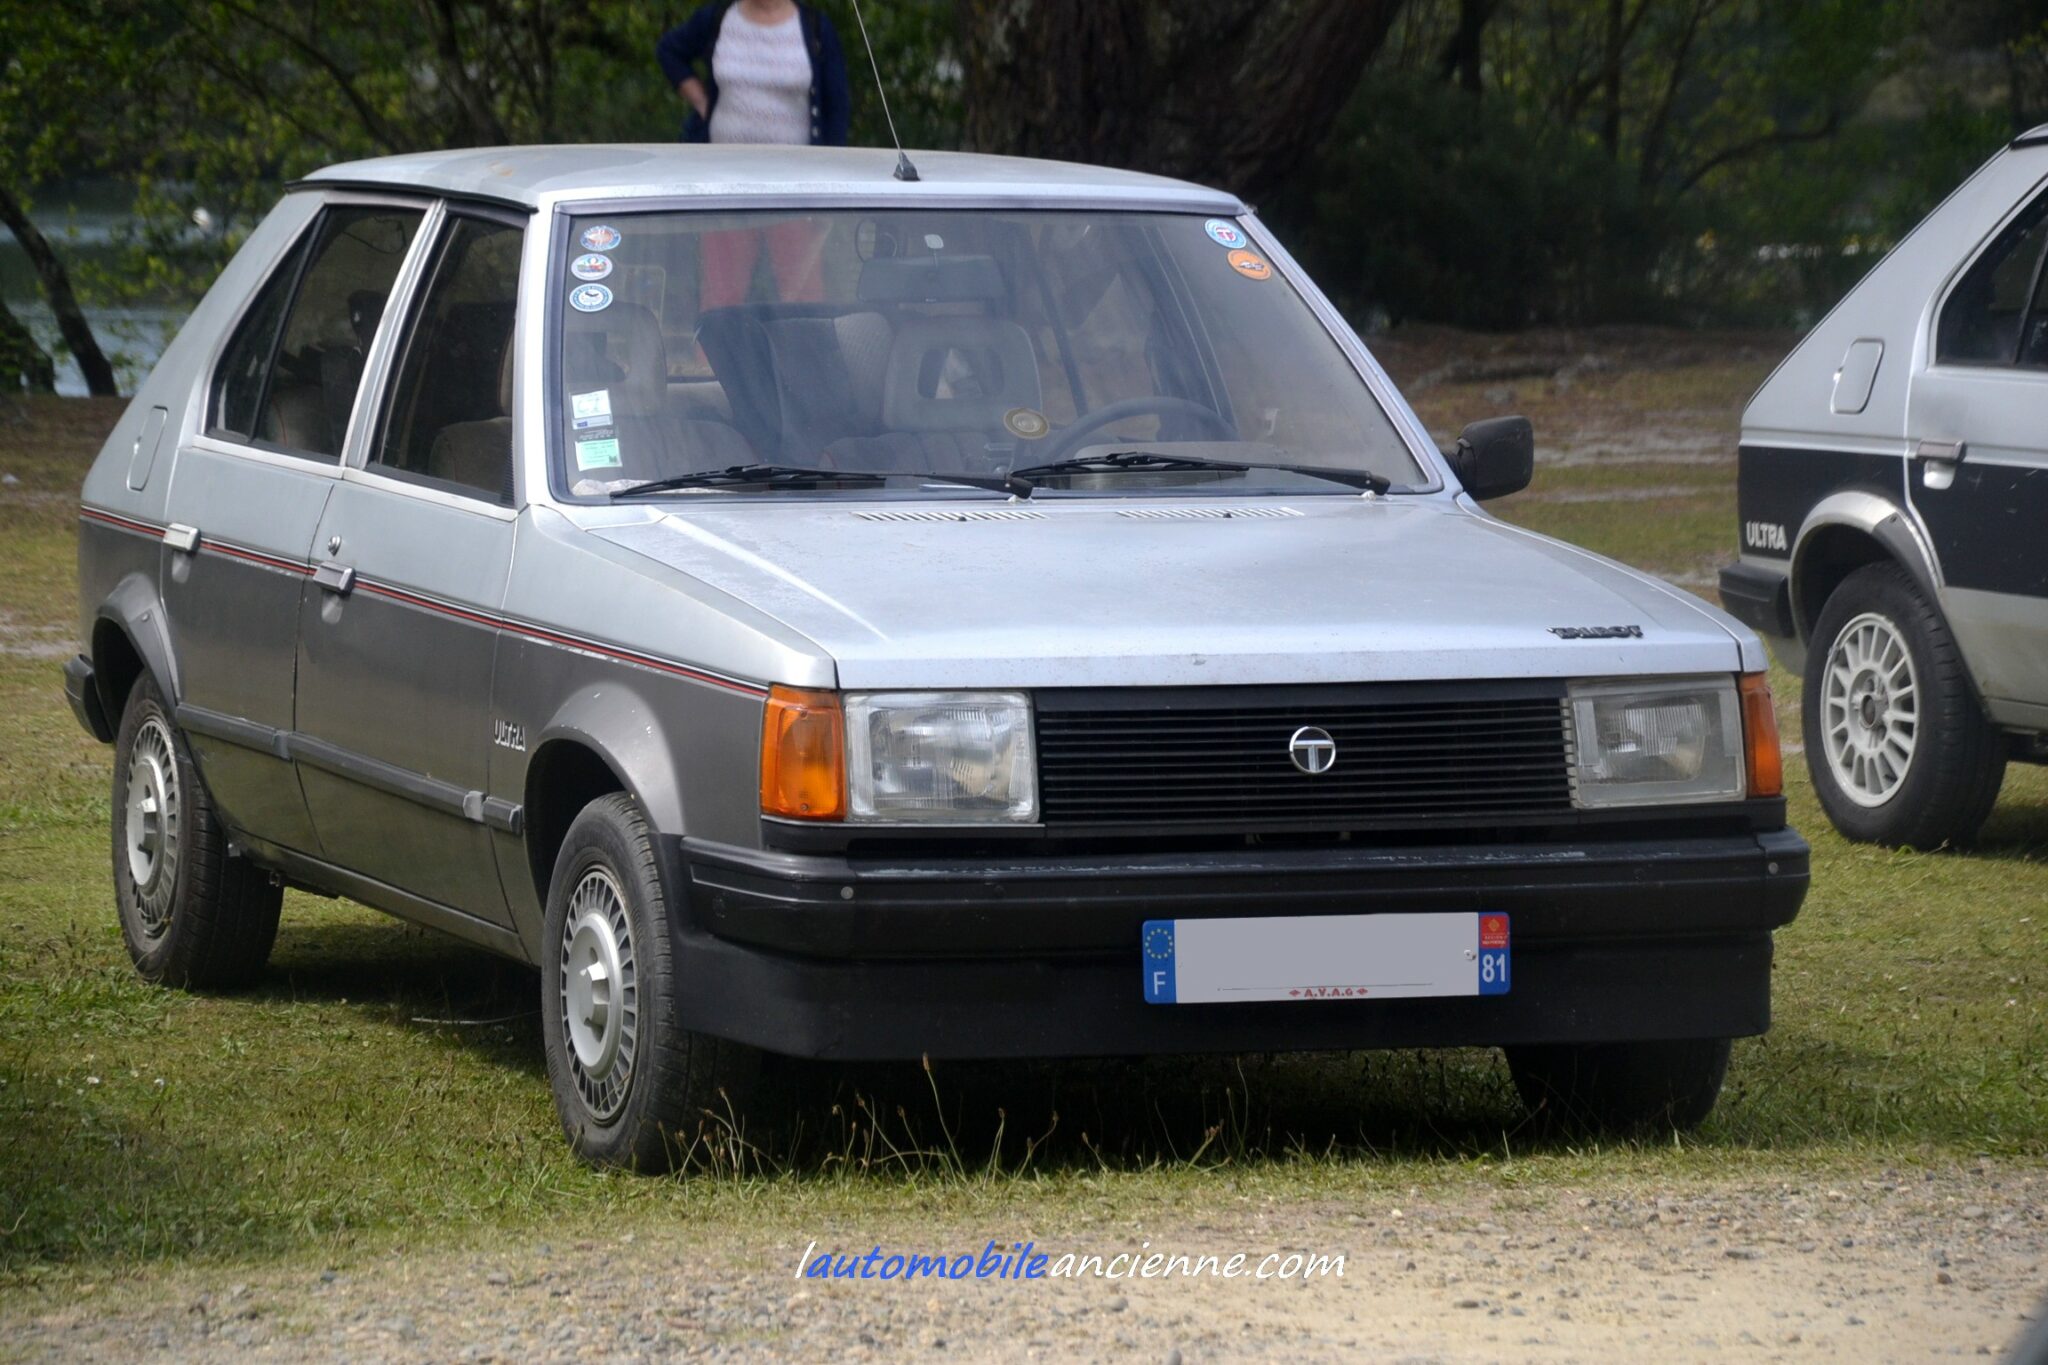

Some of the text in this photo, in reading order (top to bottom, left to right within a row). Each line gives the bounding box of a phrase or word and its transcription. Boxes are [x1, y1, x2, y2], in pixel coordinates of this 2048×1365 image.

[1746, 521, 1787, 551] ULTRA
[494, 718, 526, 752] ULTRA
[1153, 971, 1166, 995] F
[1482, 953, 1506, 983] 81
